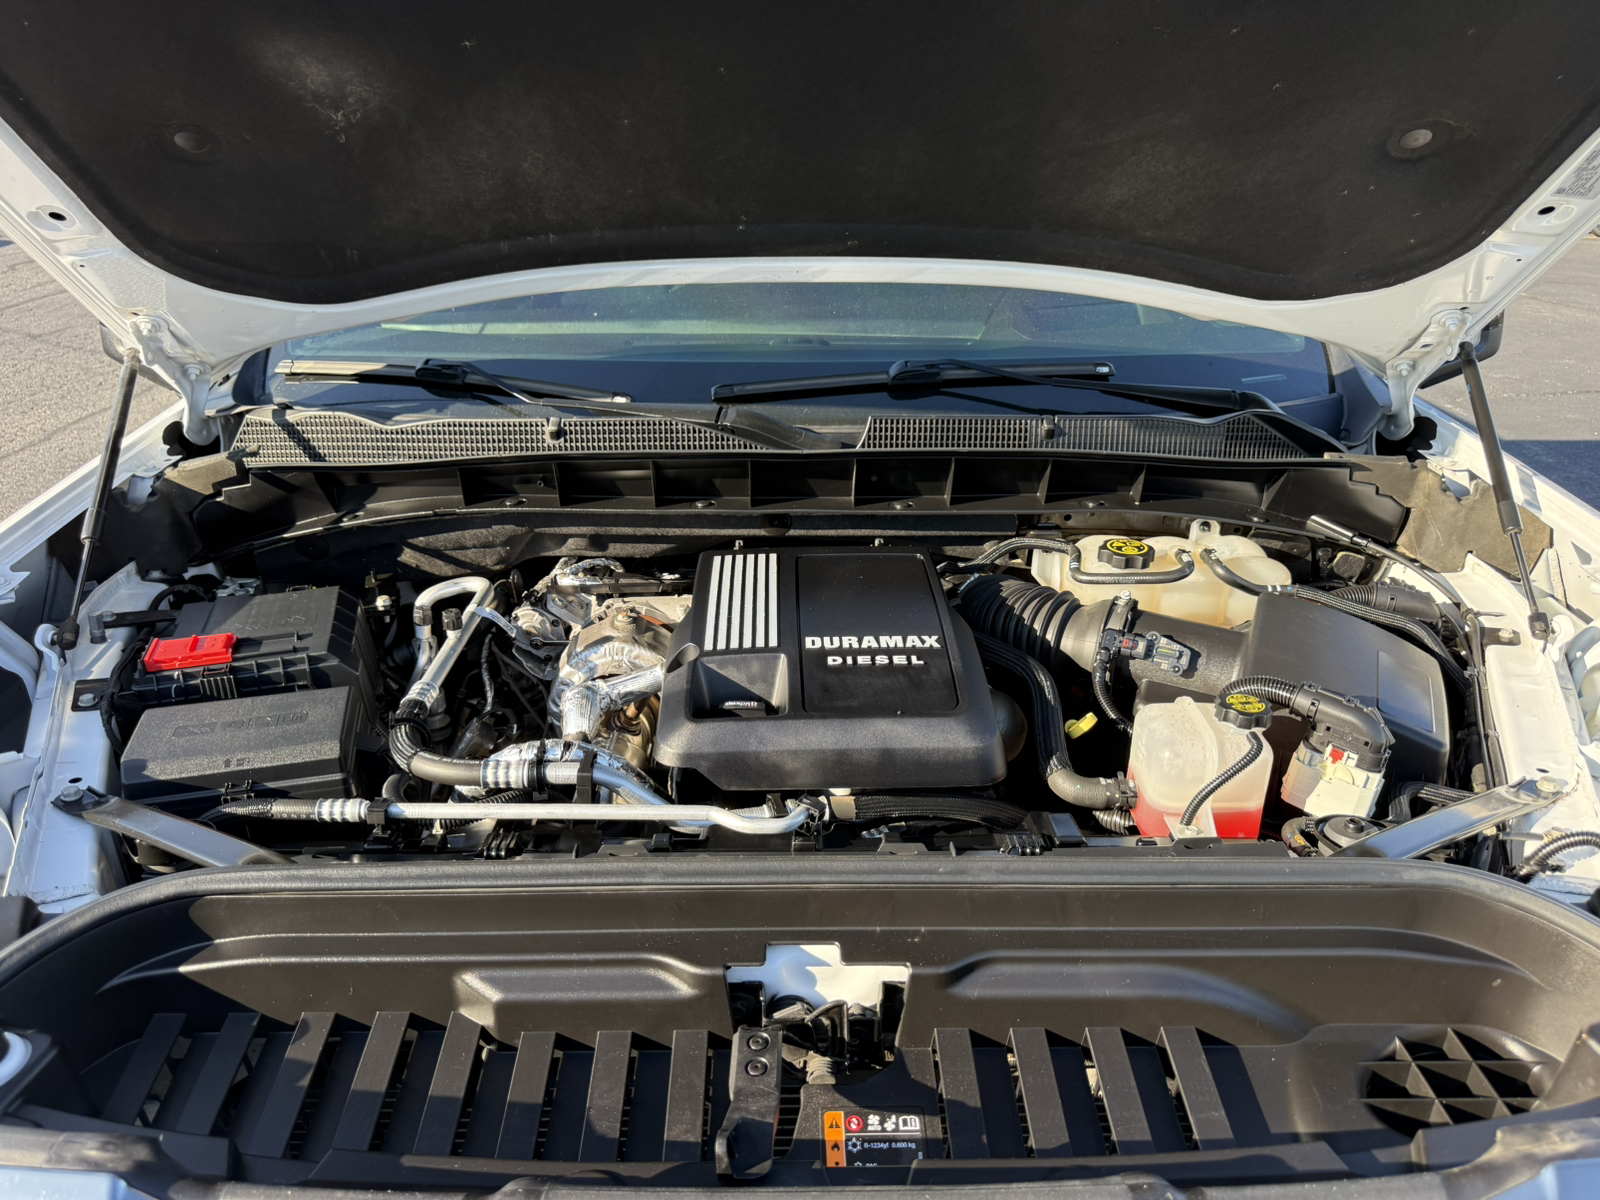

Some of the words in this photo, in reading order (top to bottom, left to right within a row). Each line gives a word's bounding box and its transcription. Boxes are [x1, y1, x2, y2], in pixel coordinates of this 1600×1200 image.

[804, 635, 942, 649] DURAMAX
[827, 655, 925, 666] DIESEL
[908, 1141, 916, 1149] kg
